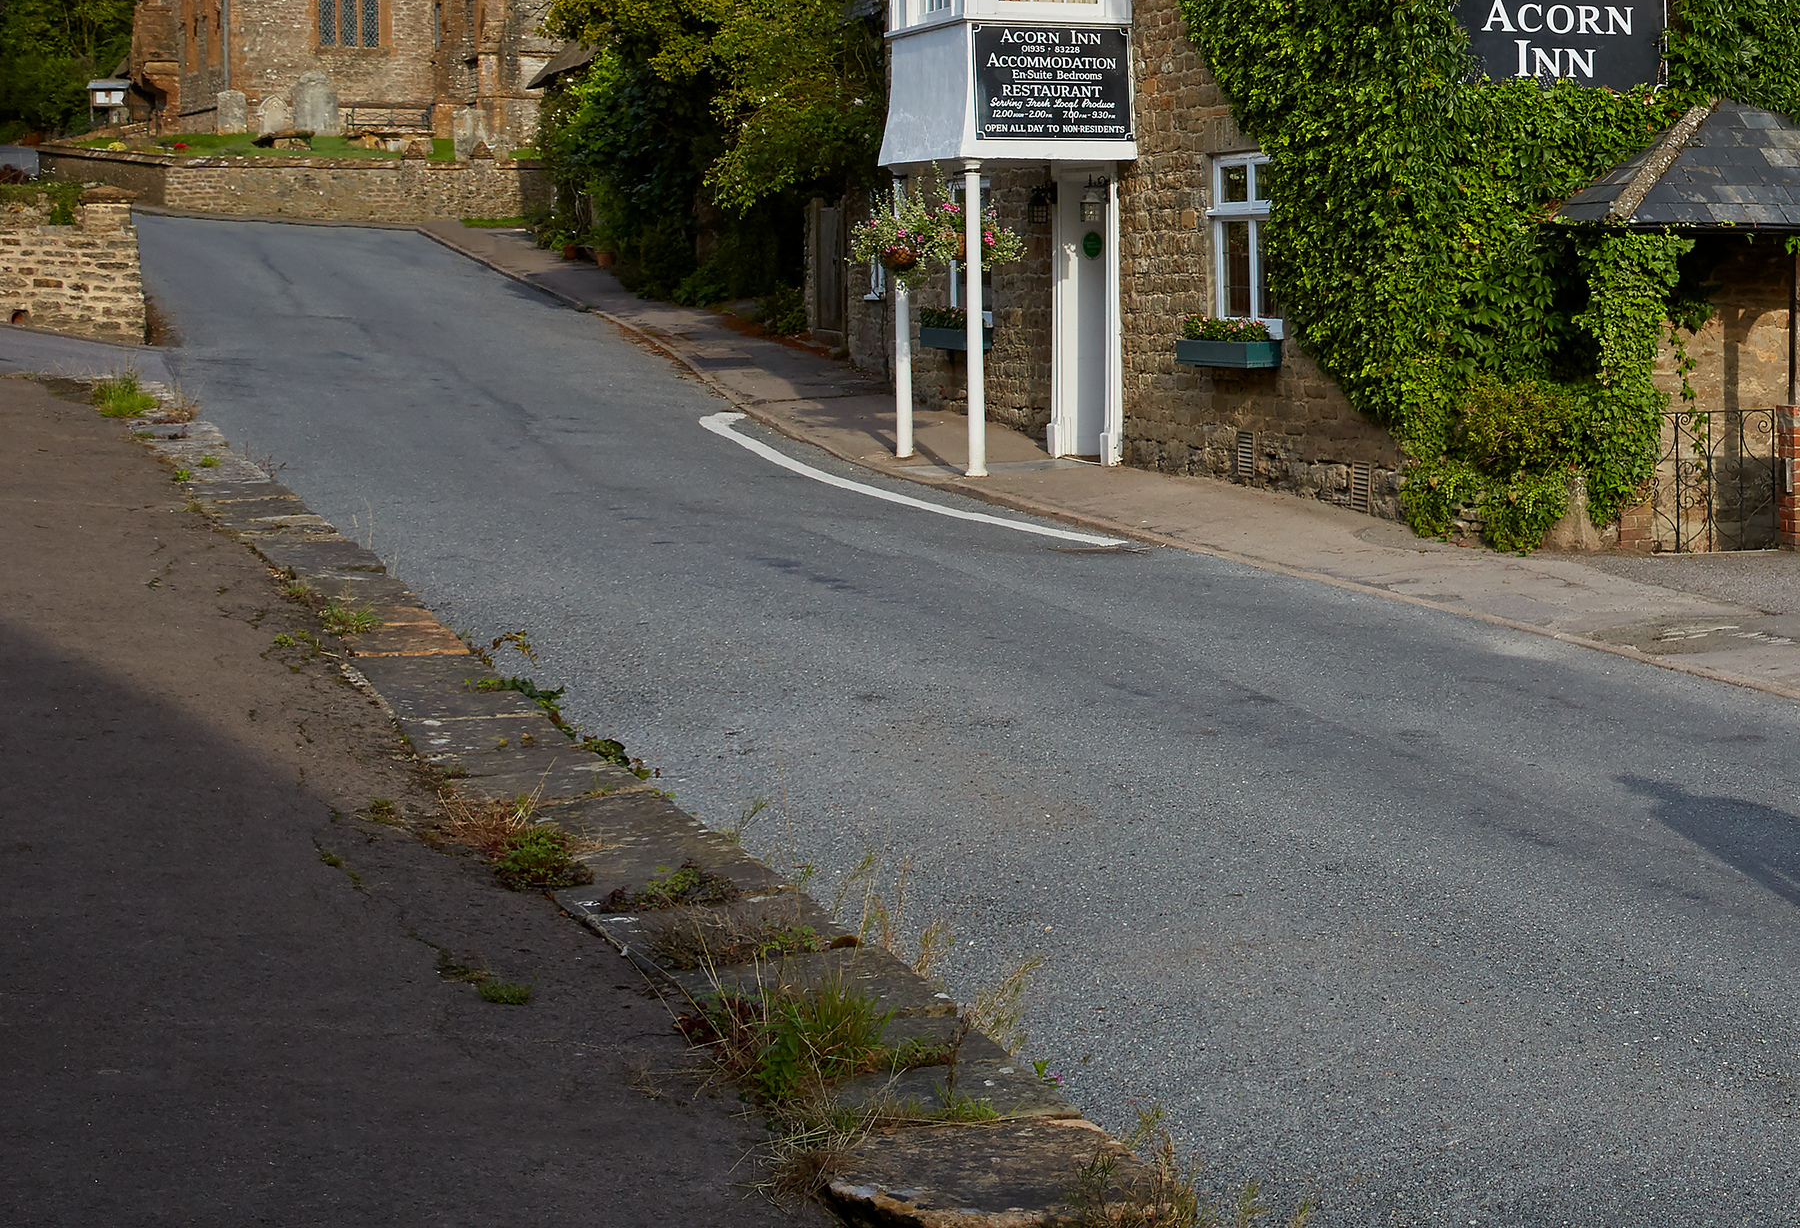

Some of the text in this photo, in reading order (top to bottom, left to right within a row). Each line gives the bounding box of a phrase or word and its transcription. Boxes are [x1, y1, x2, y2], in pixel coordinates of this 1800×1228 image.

[1000, 28, 1102, 45] ACORN INN
[1021, 45, 1081, 54] 01935 83228
[986, 52, 1117, 70] ACCOMMODATION
[1513, 39, 1597, 79] INN
[1056, 70, 1103, 81] Bedrooms
[1002, 84, 1103, 98] RESTAURANT
[990, 97, 1116, 110] Serving Fresh Local Produce
[984, 123, 1126, 134] OPEN ALL DAY TO NON-RESIDENTS
